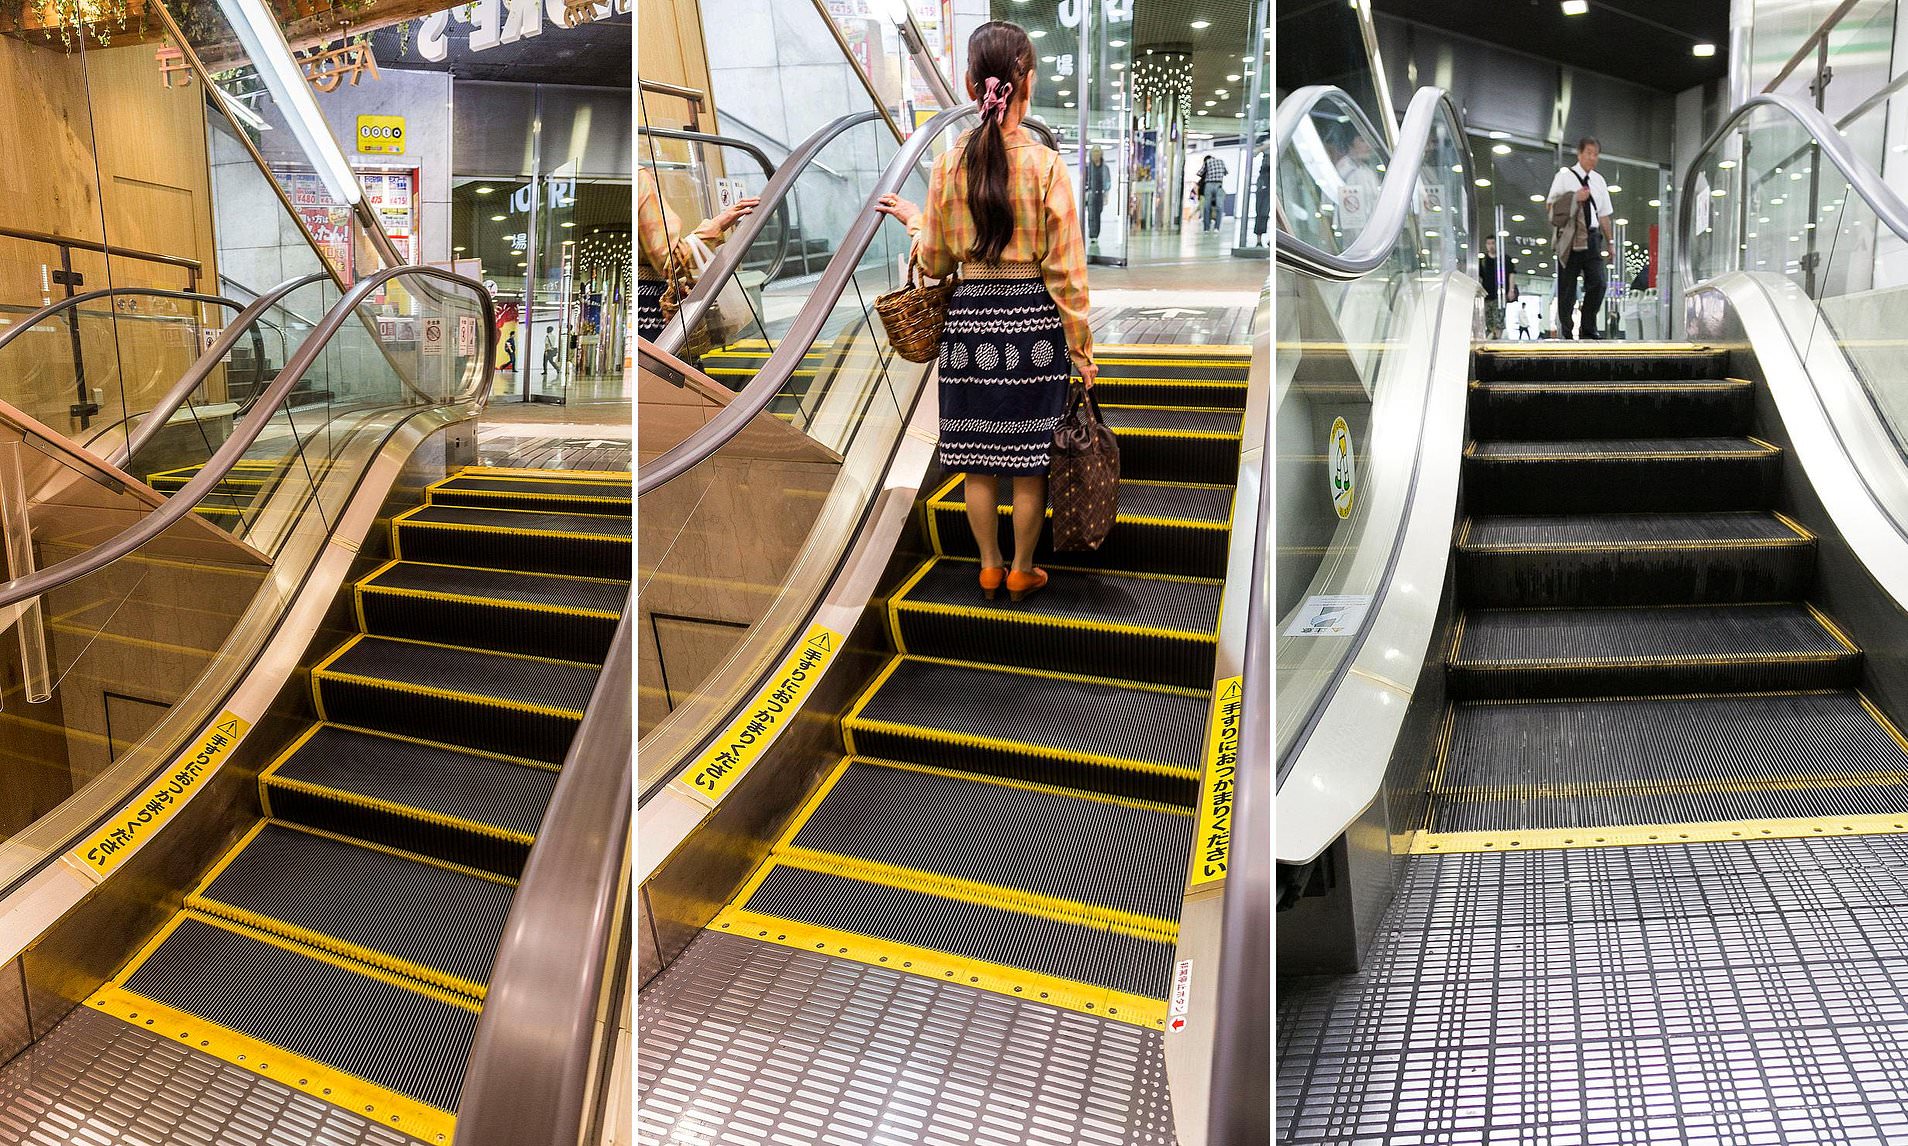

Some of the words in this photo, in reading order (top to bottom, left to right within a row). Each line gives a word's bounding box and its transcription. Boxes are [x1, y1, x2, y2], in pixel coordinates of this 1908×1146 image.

[360, 125, 402, 138] toto
[695, 648, 823, 790] 手すりにおつかまりください
[87, 733, 229, 866] 手すりにおつかまりください
[1203, 701, 1241, 877] 手すりにおつかまりください
